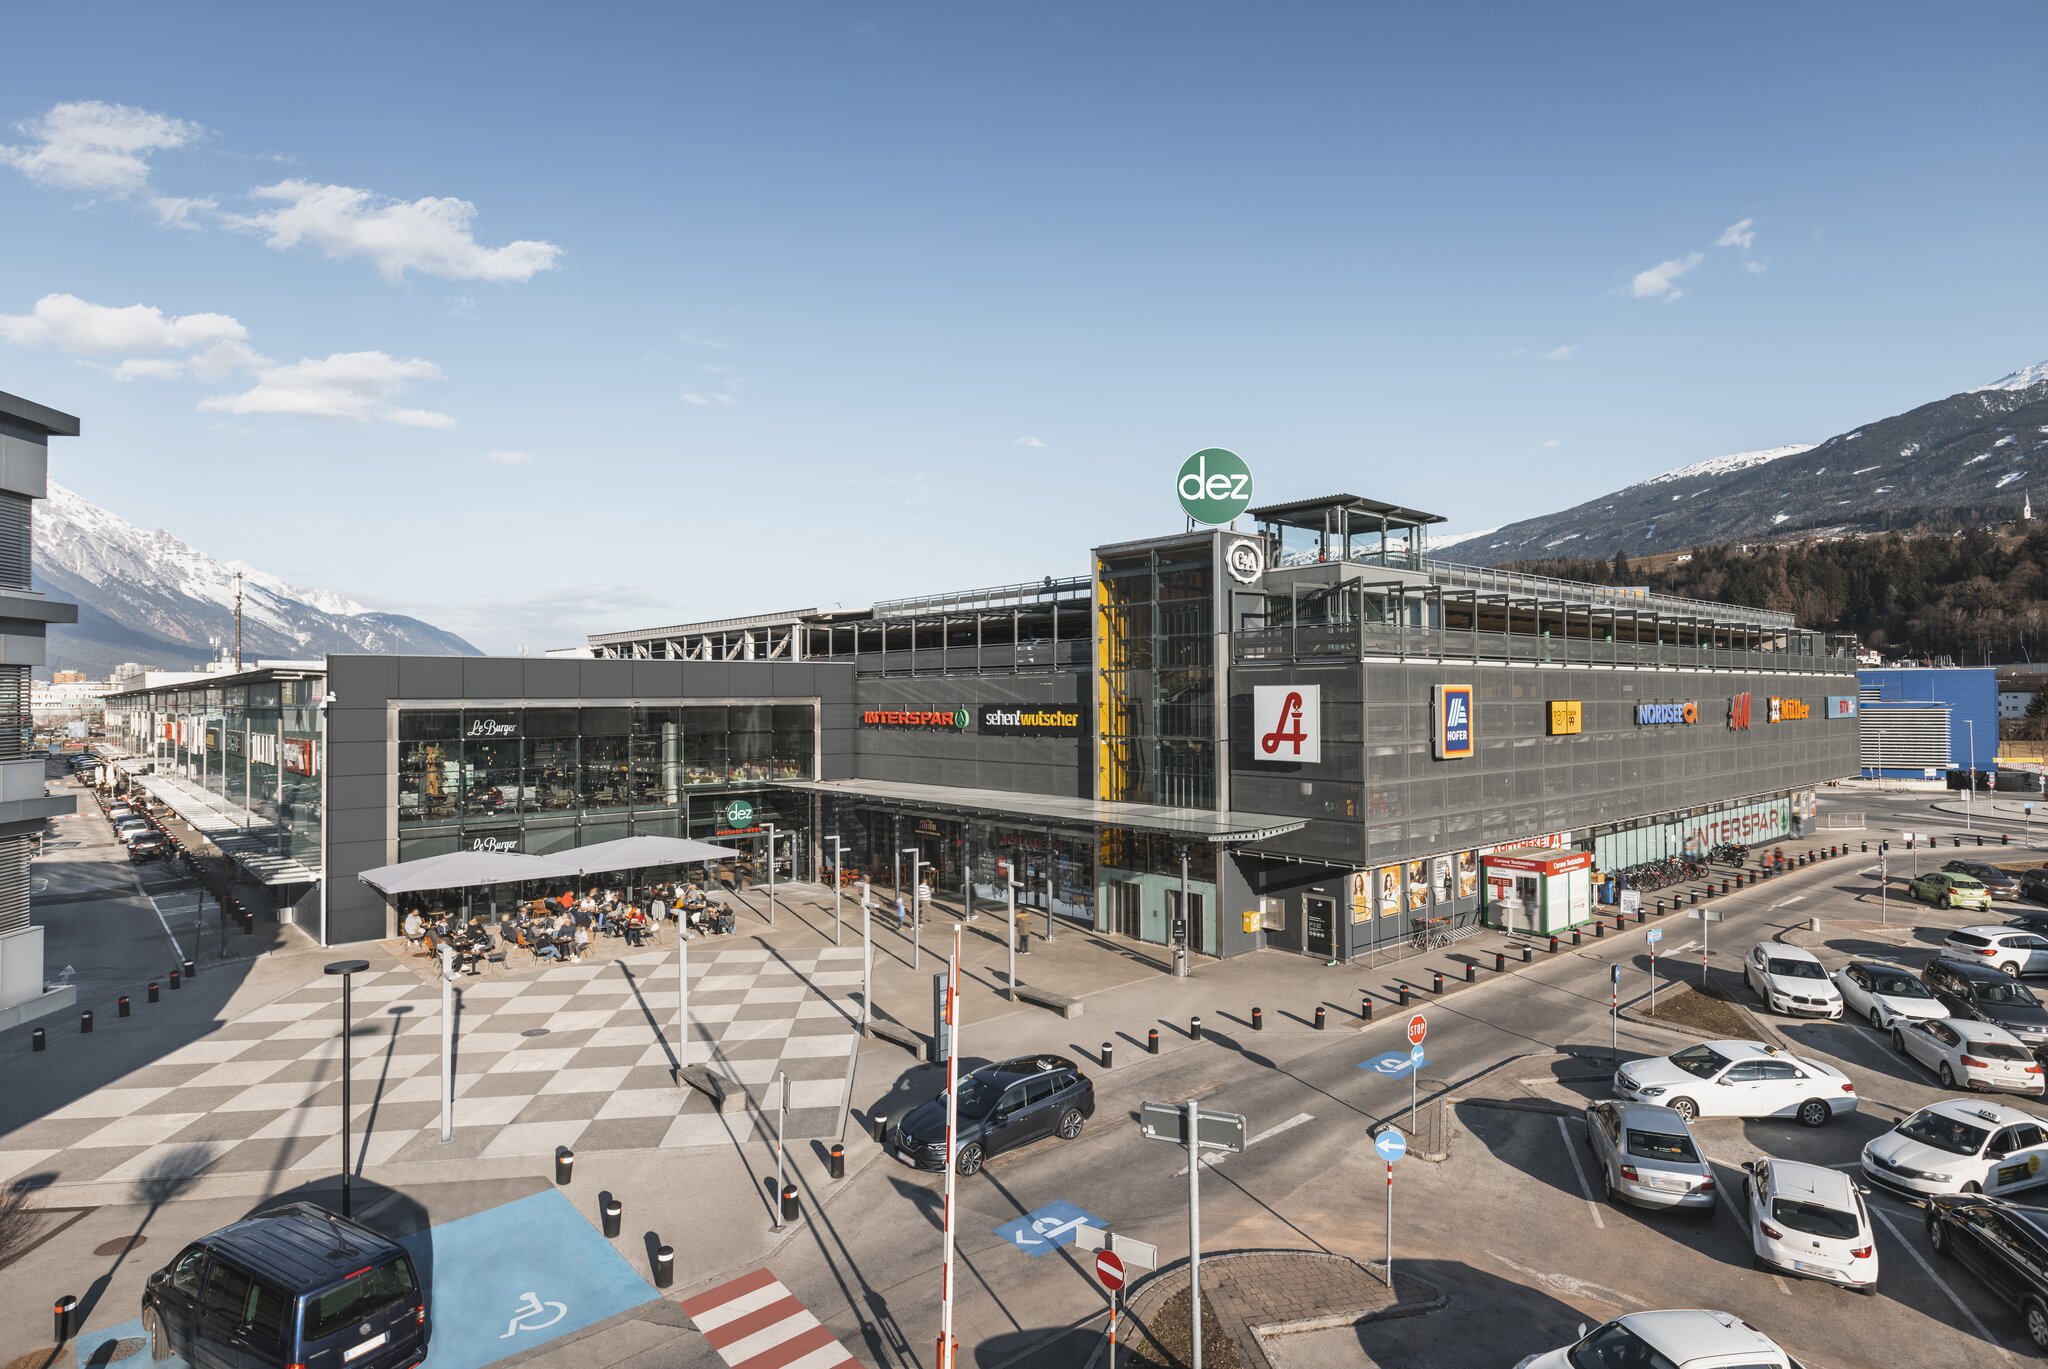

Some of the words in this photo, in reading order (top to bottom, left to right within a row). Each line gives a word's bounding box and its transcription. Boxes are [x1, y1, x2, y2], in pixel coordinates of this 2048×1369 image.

[1178, 455, 1249, 500] dez
[1233, 551, 1258, 572] C&A
[1639, 703, 1684, 724] NORDSEE
[1781, 698, 1809, 720] Müller
[864, 710, 954, 726] INTERSPAR
[467, 719, 484, 736] Le
[483, 719, 517, 736] Burger
[1447, 730, 1468, 741] HOFER
[728, 803, 753, 821] dez
[483, 836, 518, 853] Burger
[1410, 1022, 1425, 1037] STOP
[1979, 1109, 1998, 1120] TAXI
